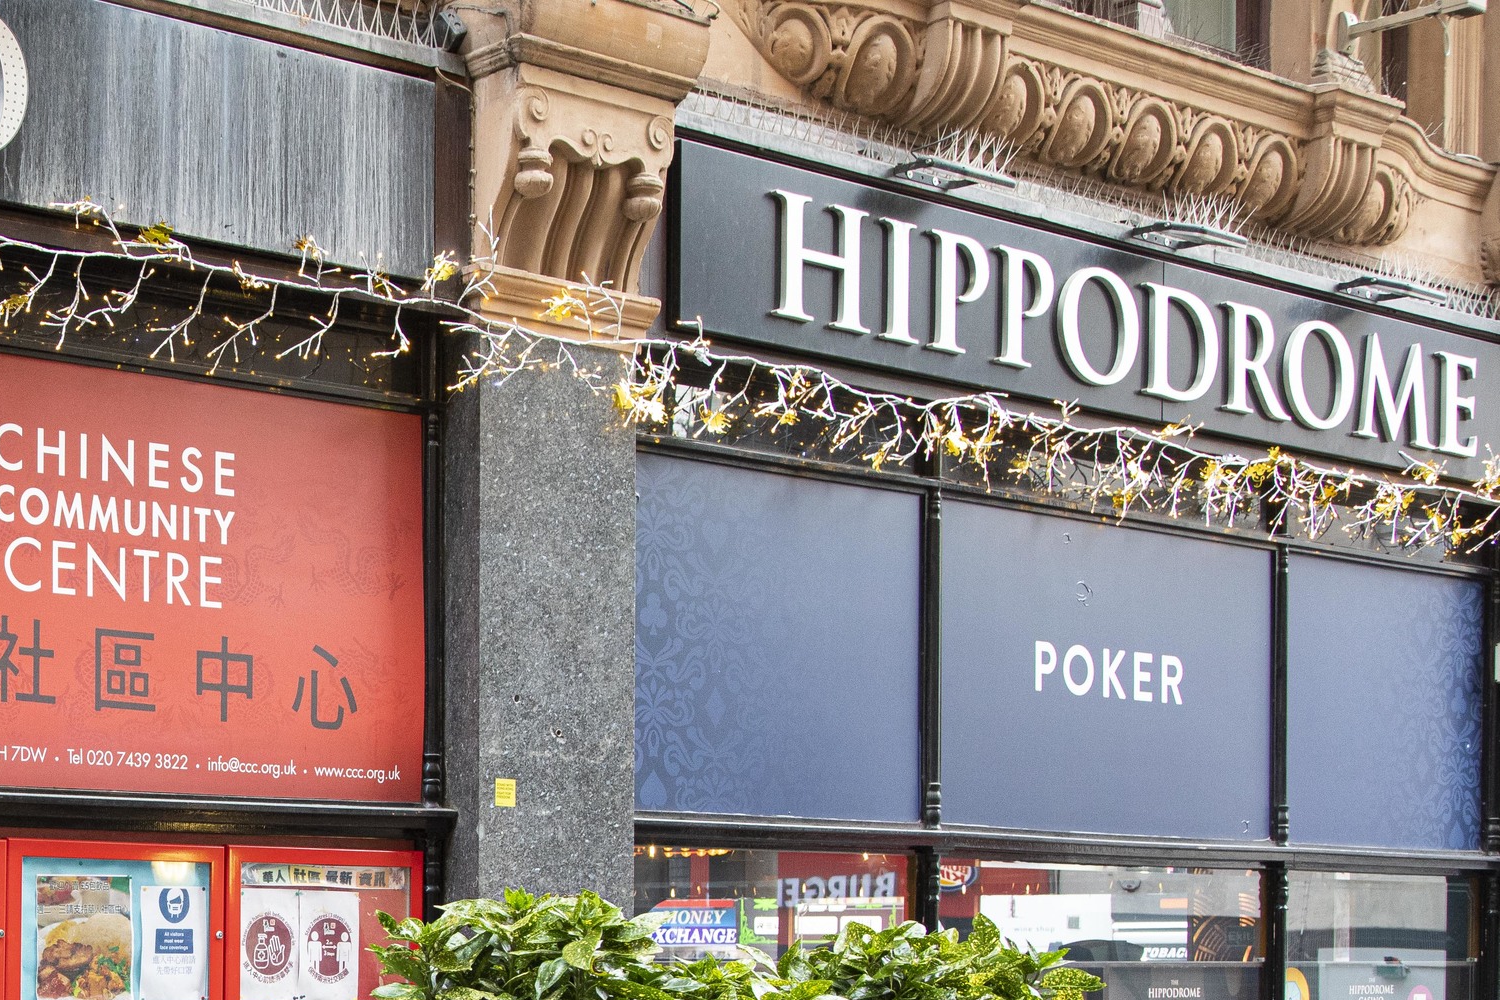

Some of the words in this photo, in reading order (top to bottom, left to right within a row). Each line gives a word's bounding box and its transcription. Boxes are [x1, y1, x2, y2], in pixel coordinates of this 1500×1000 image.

[770, 189, 1478, 458] HIPPODROME
[4, 536, 222, 609] CENTRE
[1033, 640, 1184, 705] POKER
[11, 746, 47, 763] 7DW
[67, 748, 83, 764] Tel
[87, 750, 113, 766] 020
[117, 751, 150, 768] 7439
[155, 753, 188, 770] 3822
[207, 757, 297, 778] info@ccc.org.uk
[314, 765, 401, 784] www.ccc.org.uk
[663, 909, 727, 925] MONEY
[651, 928, 737, 944] XCHANGE
[1142, 947, 1187, 958] TOBAC
[1148, 987, 1201, 998] HIPPODROME
[1349, 984, 1394, 995] HIPPODROME
